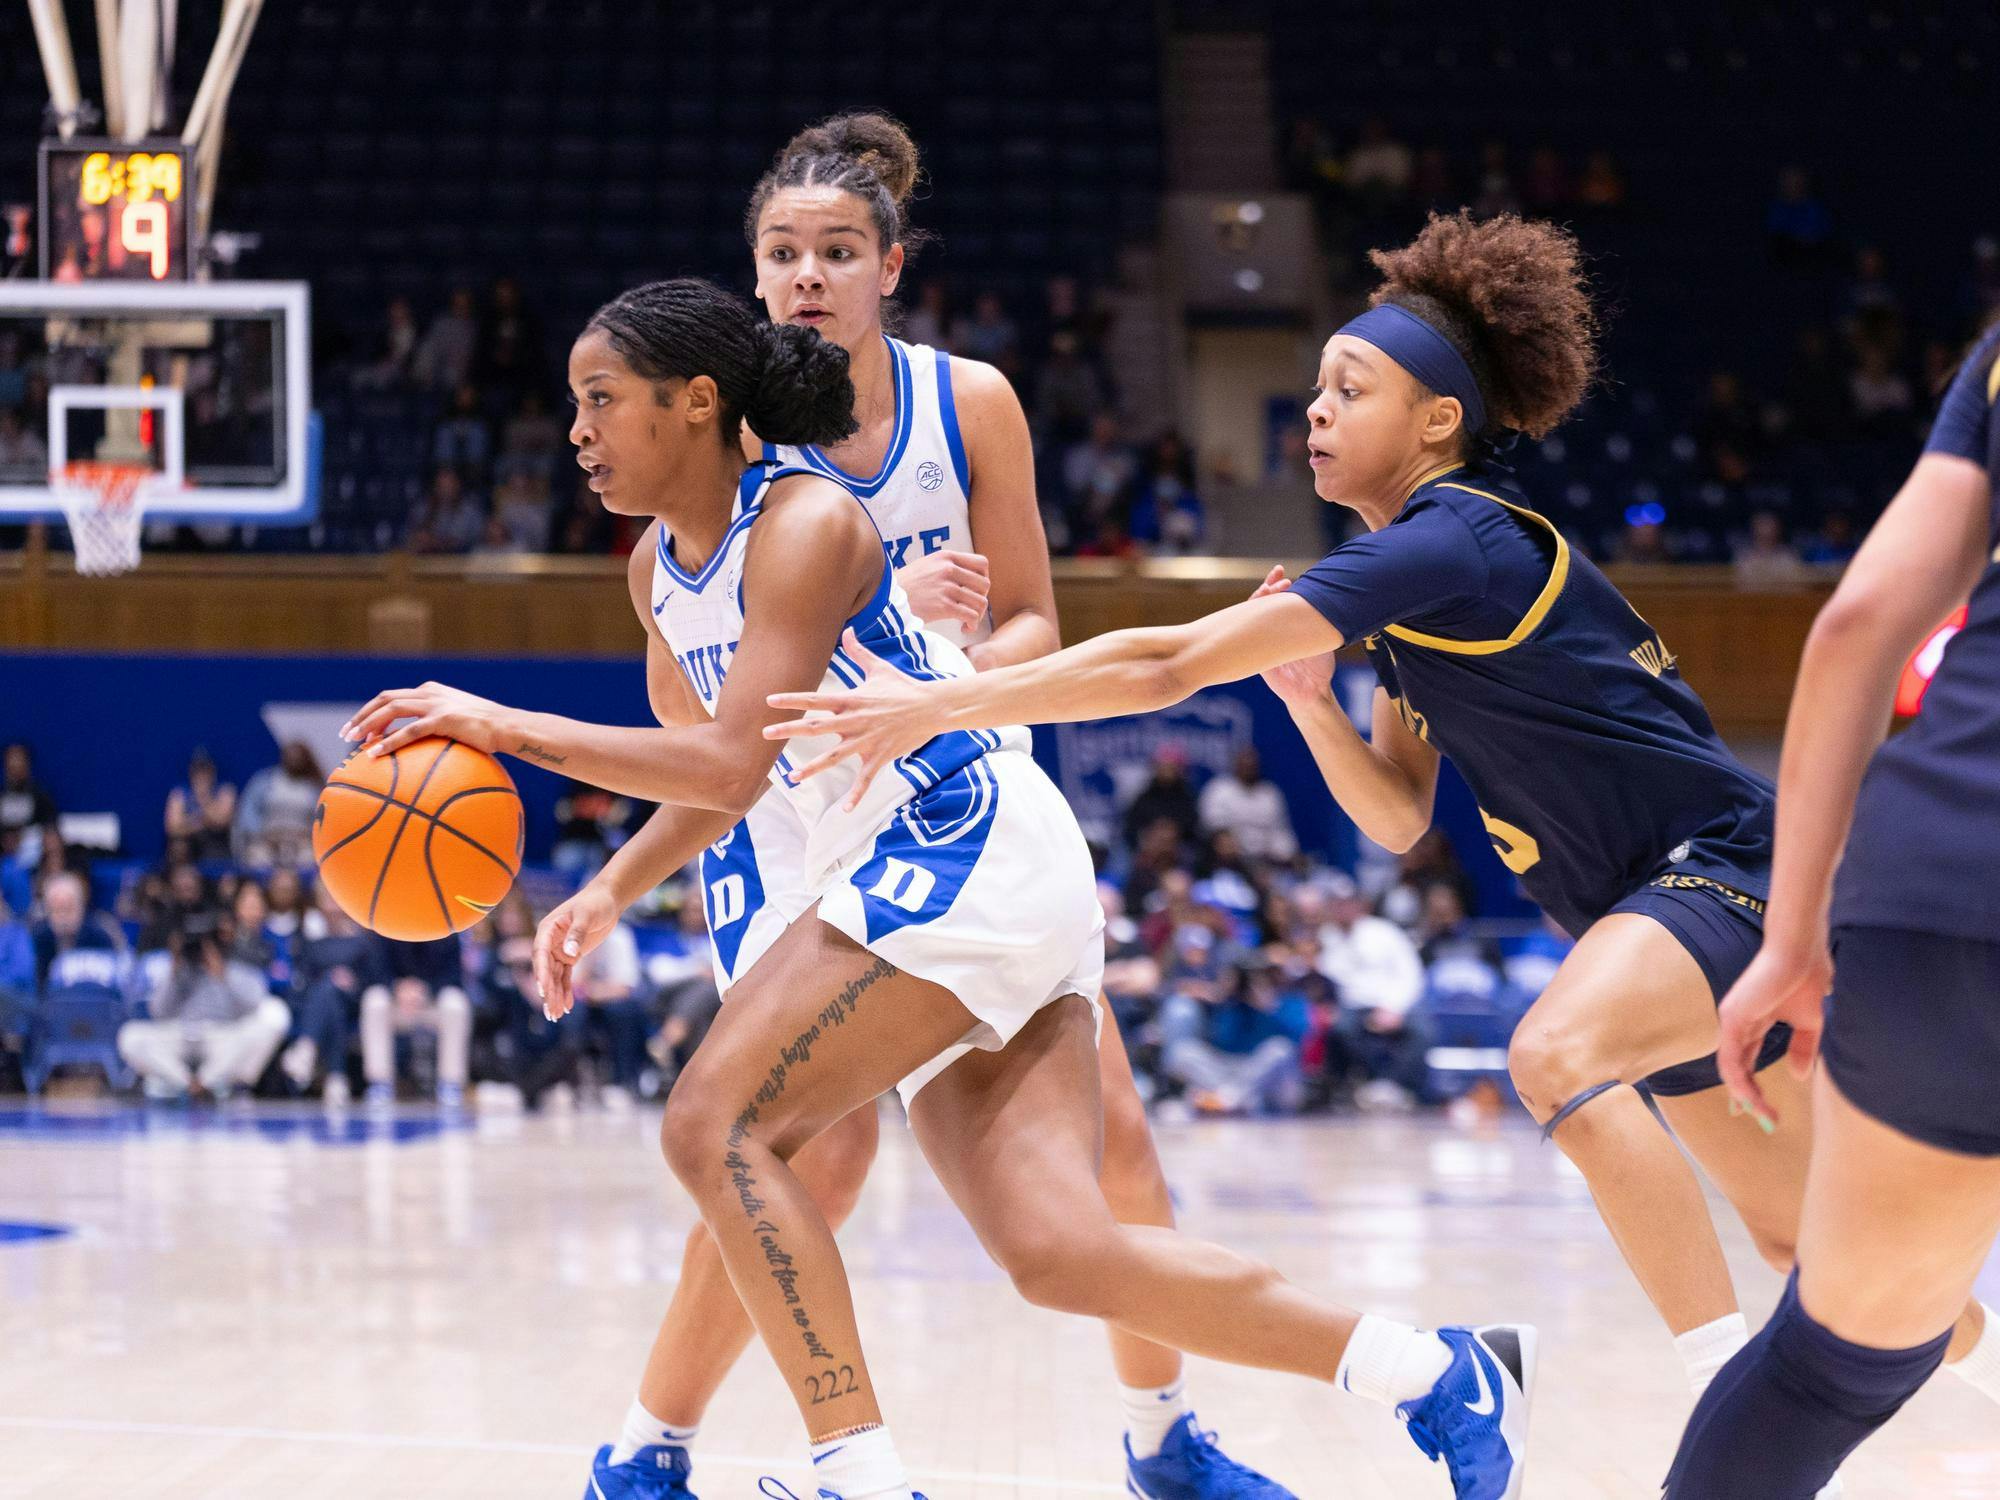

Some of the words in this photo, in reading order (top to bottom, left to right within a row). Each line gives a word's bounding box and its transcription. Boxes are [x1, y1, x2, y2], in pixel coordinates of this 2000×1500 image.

[81, 152, 182, 205] 6:39
[121, 201, 170, 280] 9
[818, 1000, 846, 1027] the
[780, 1025, 821, 1067] valley
[755, 1080, 779, 1104] the
[769, 1063, 786, 1091] of
[726, 1102, 759, 1149] shadow
[760, 1235, 793, 1266] will
[771, 1263, 800, 1305] fear
[792, 1307, 811, 1330] no
[803, 1331, 834, 1361] evil
[804, 1364, 859, 1405] 222
